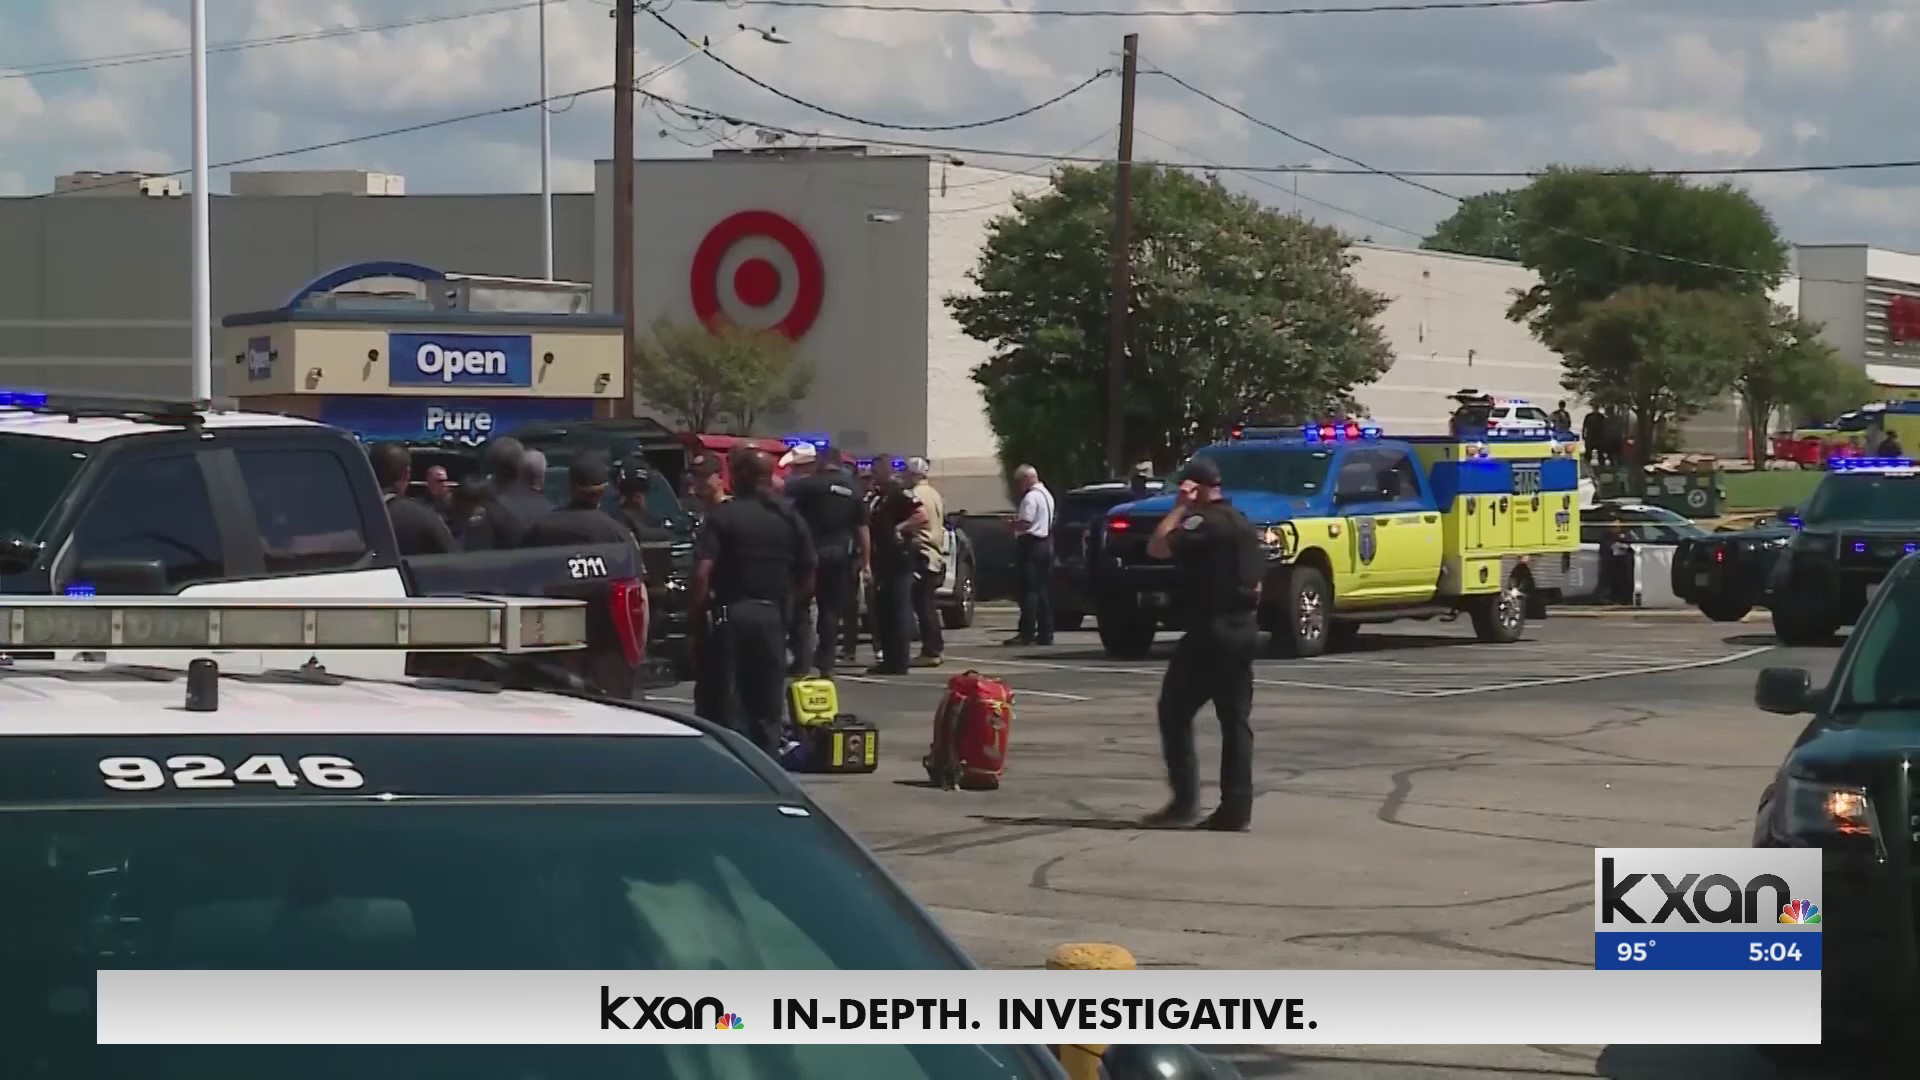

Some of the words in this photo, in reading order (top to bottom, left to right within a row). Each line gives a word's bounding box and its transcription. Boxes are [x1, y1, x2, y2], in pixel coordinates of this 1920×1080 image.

[417, 343, 507, 382] Open
[427, 407, 492, 431] Pure
[1489, 501, 1497, 526] 1
[568, 557, 607, 578] 2711
[99, 755, 364, 790] 9246
